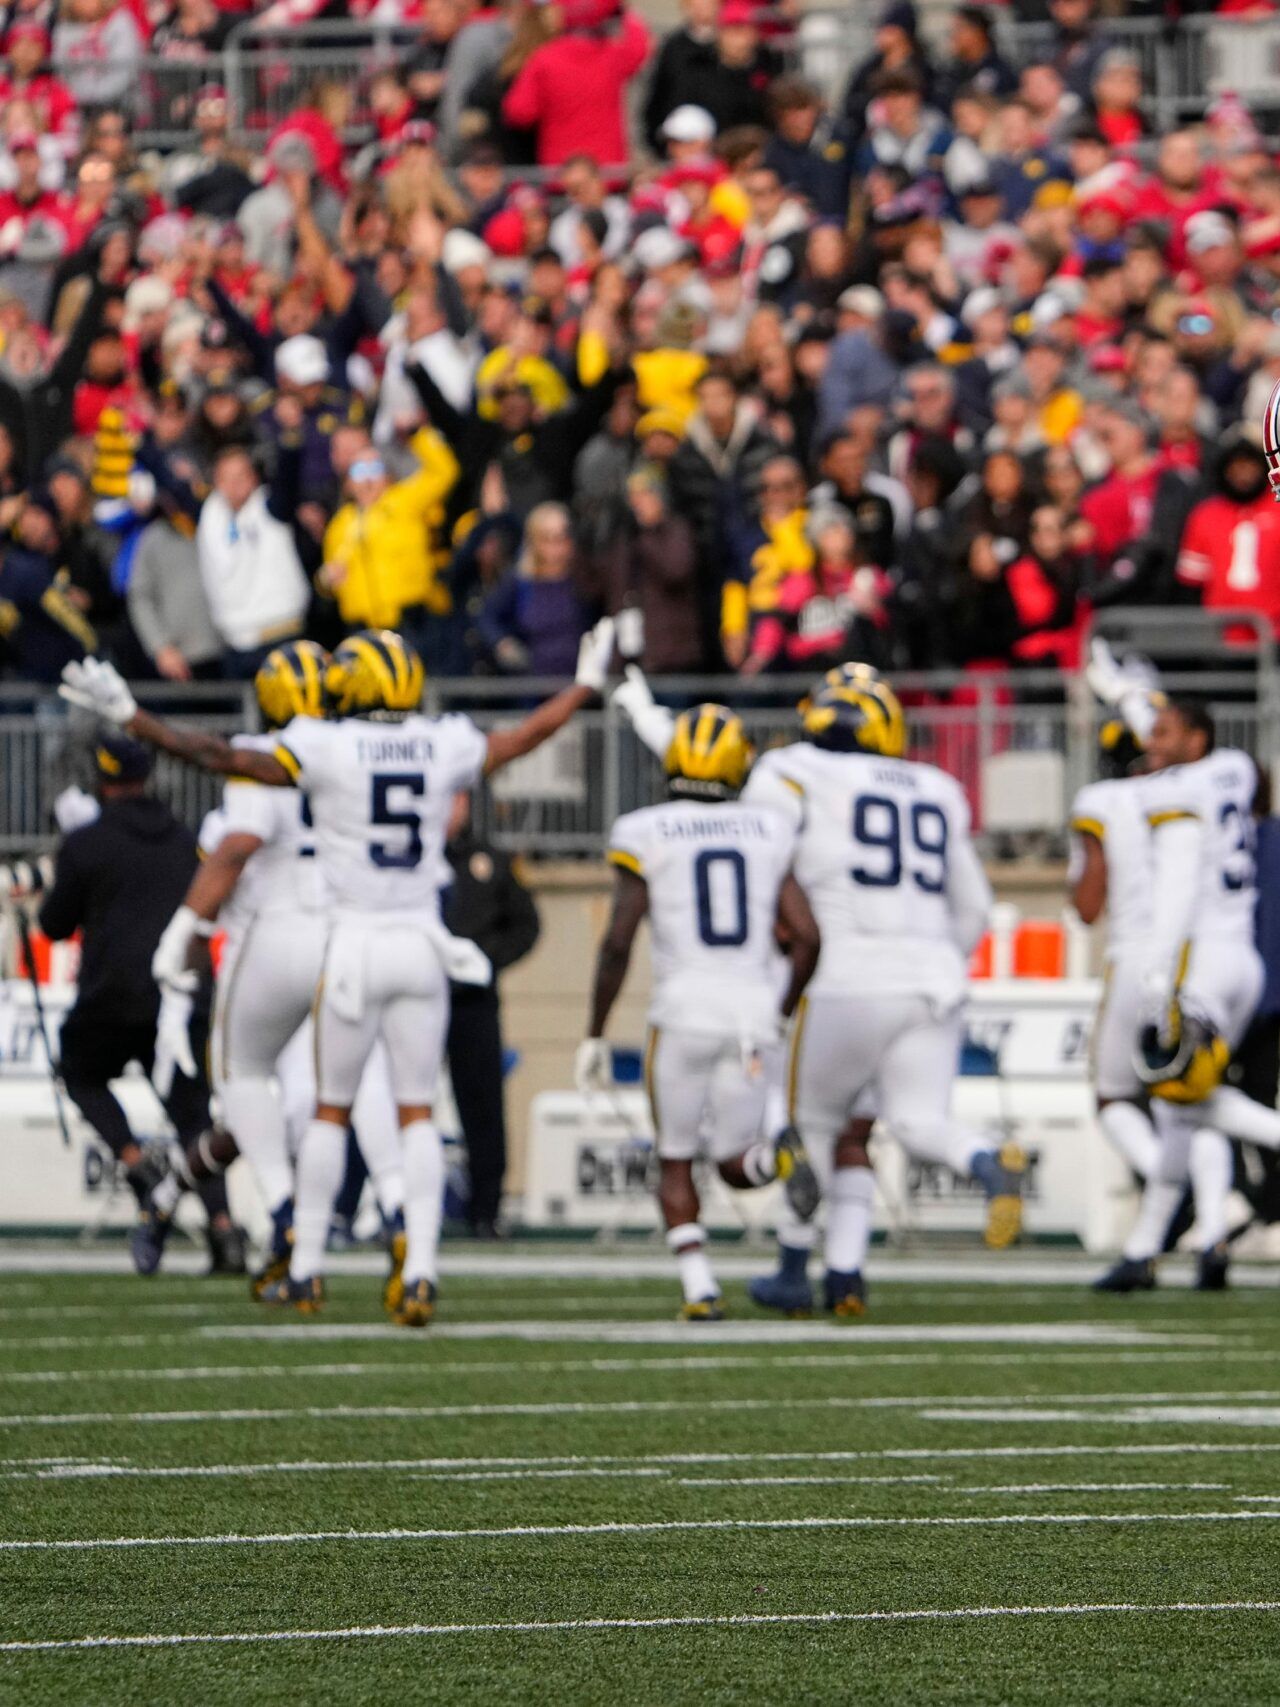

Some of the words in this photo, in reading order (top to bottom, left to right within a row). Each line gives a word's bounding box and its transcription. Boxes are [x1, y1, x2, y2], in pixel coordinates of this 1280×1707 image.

[1227, 521, 1260, 590] 1
[357, 738, 433, 763] TURNER
[371, 773, 425, 869] 5
[851, 795, 948, 893] 99
[695, 850, 748, 946] 0
